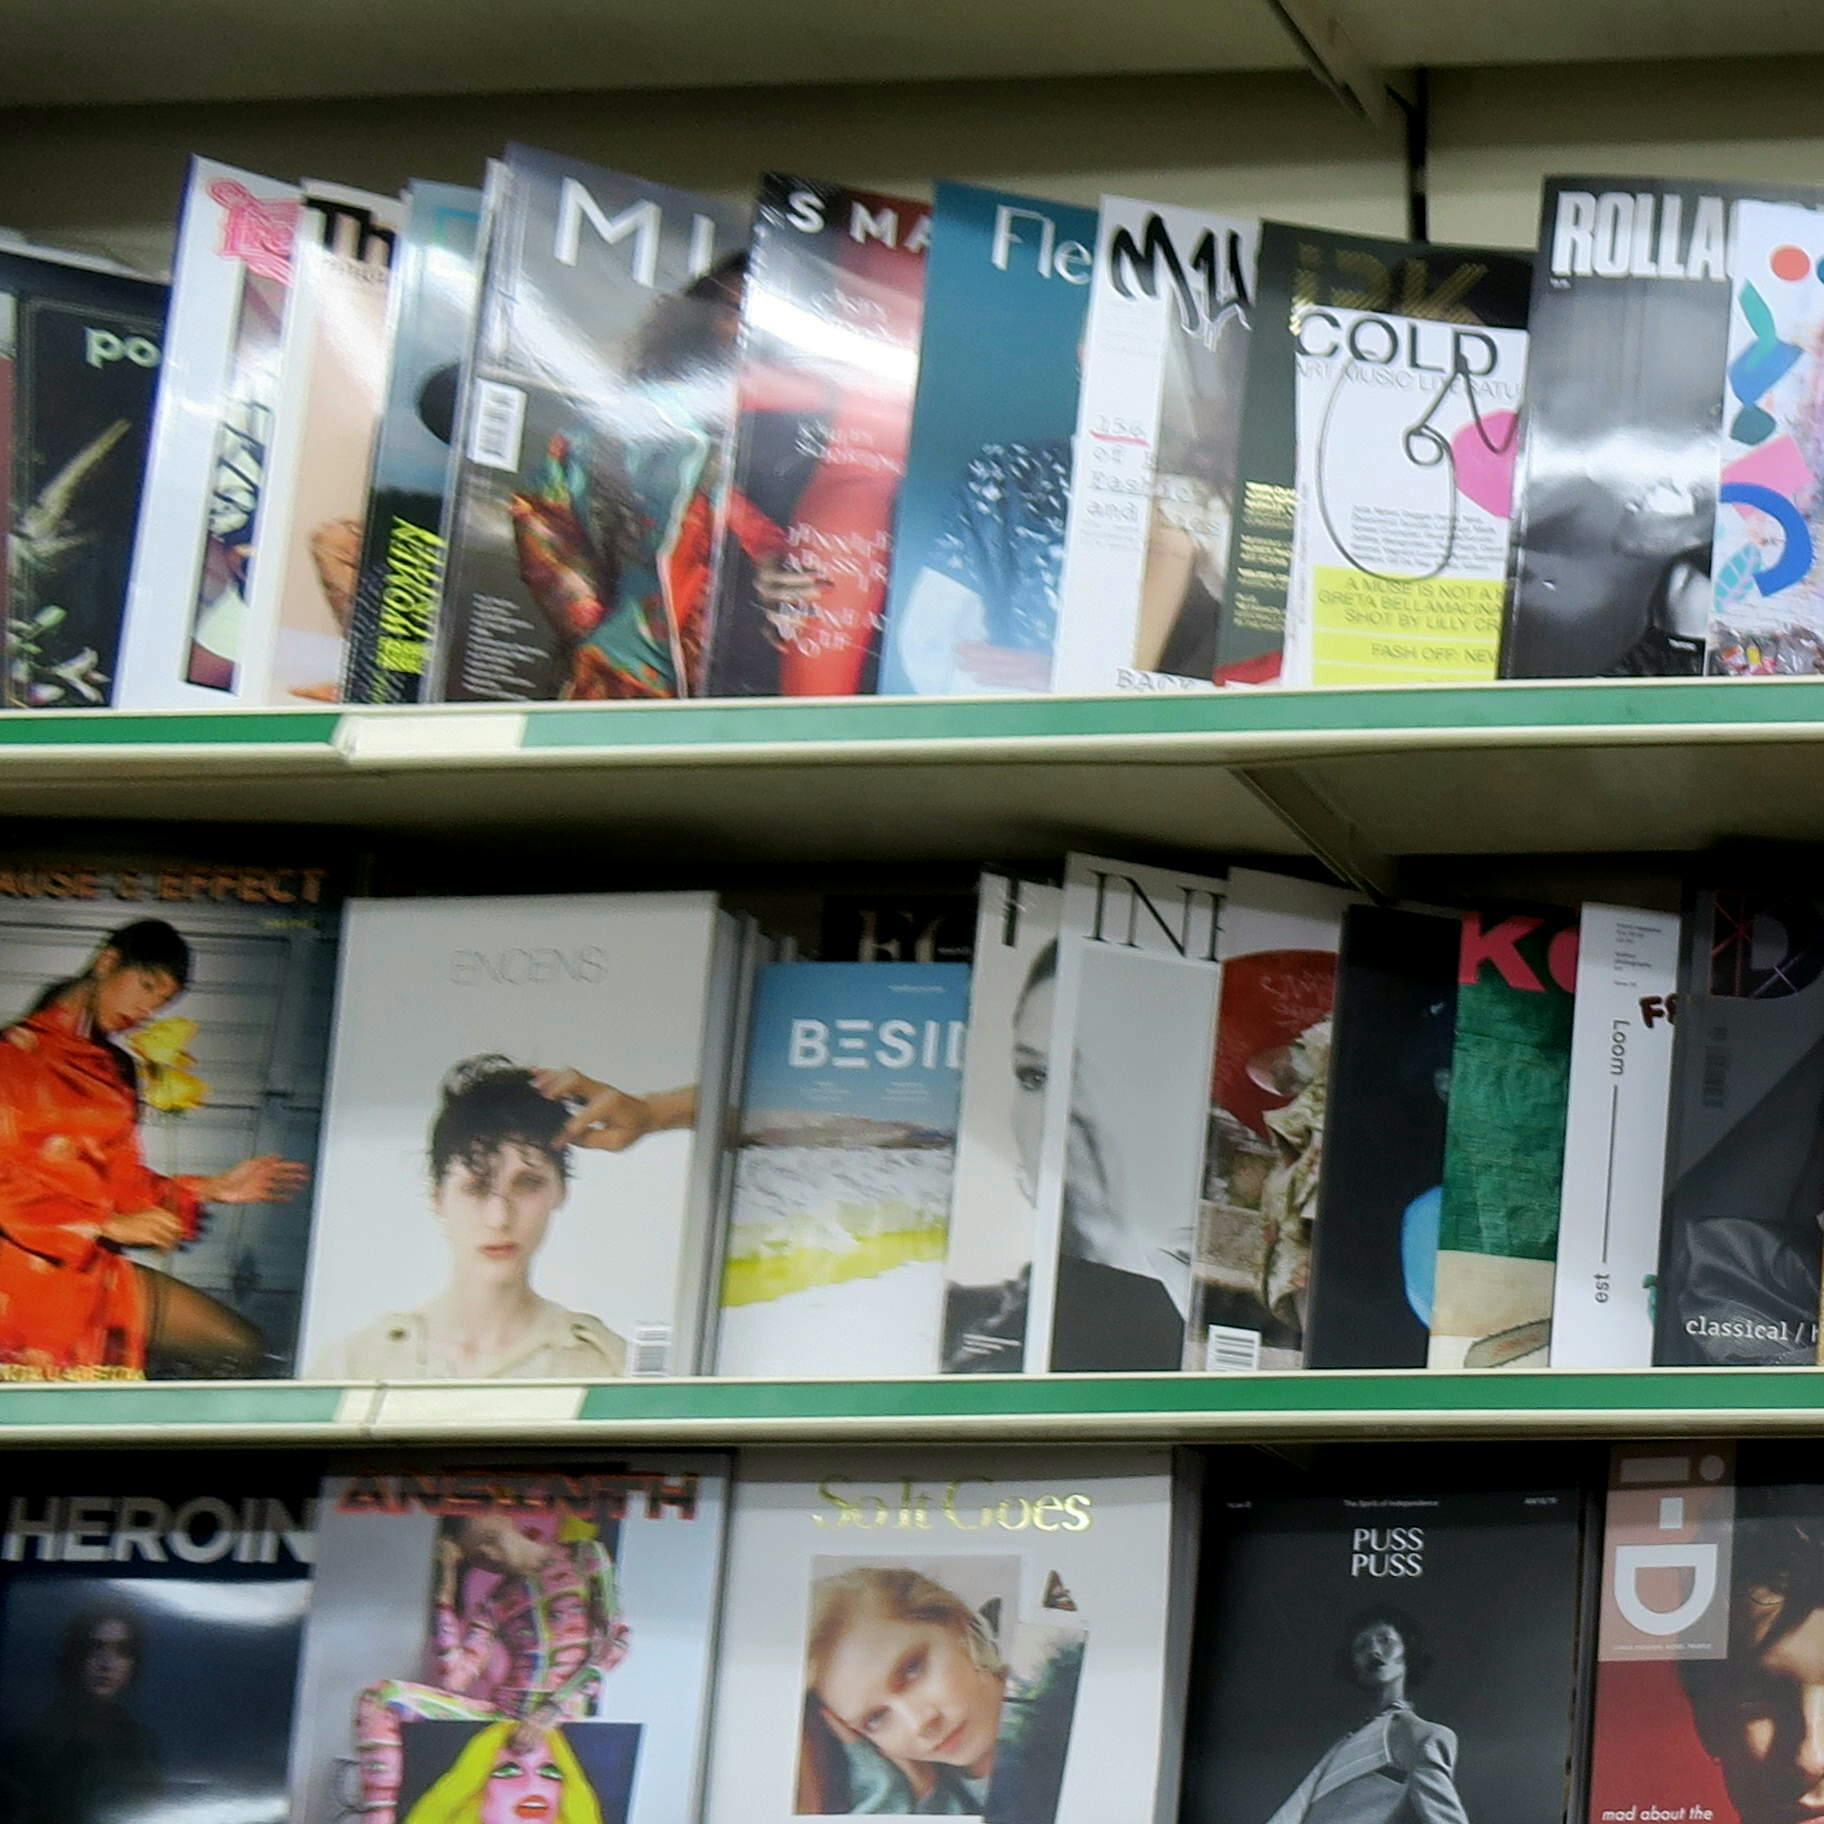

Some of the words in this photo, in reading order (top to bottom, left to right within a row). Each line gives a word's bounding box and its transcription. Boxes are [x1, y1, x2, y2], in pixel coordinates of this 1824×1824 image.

[1294, 308, 1500, 378] COLD
[1352, 1526, 1424, 1553] PUSS
[1350, 1552, 1424, 1579] PUSS
[1602, 1806, 1637, 1822] mad
[1641, 1804, 1684, 1823] about
[1688, 1804, 1713, 1822] the
